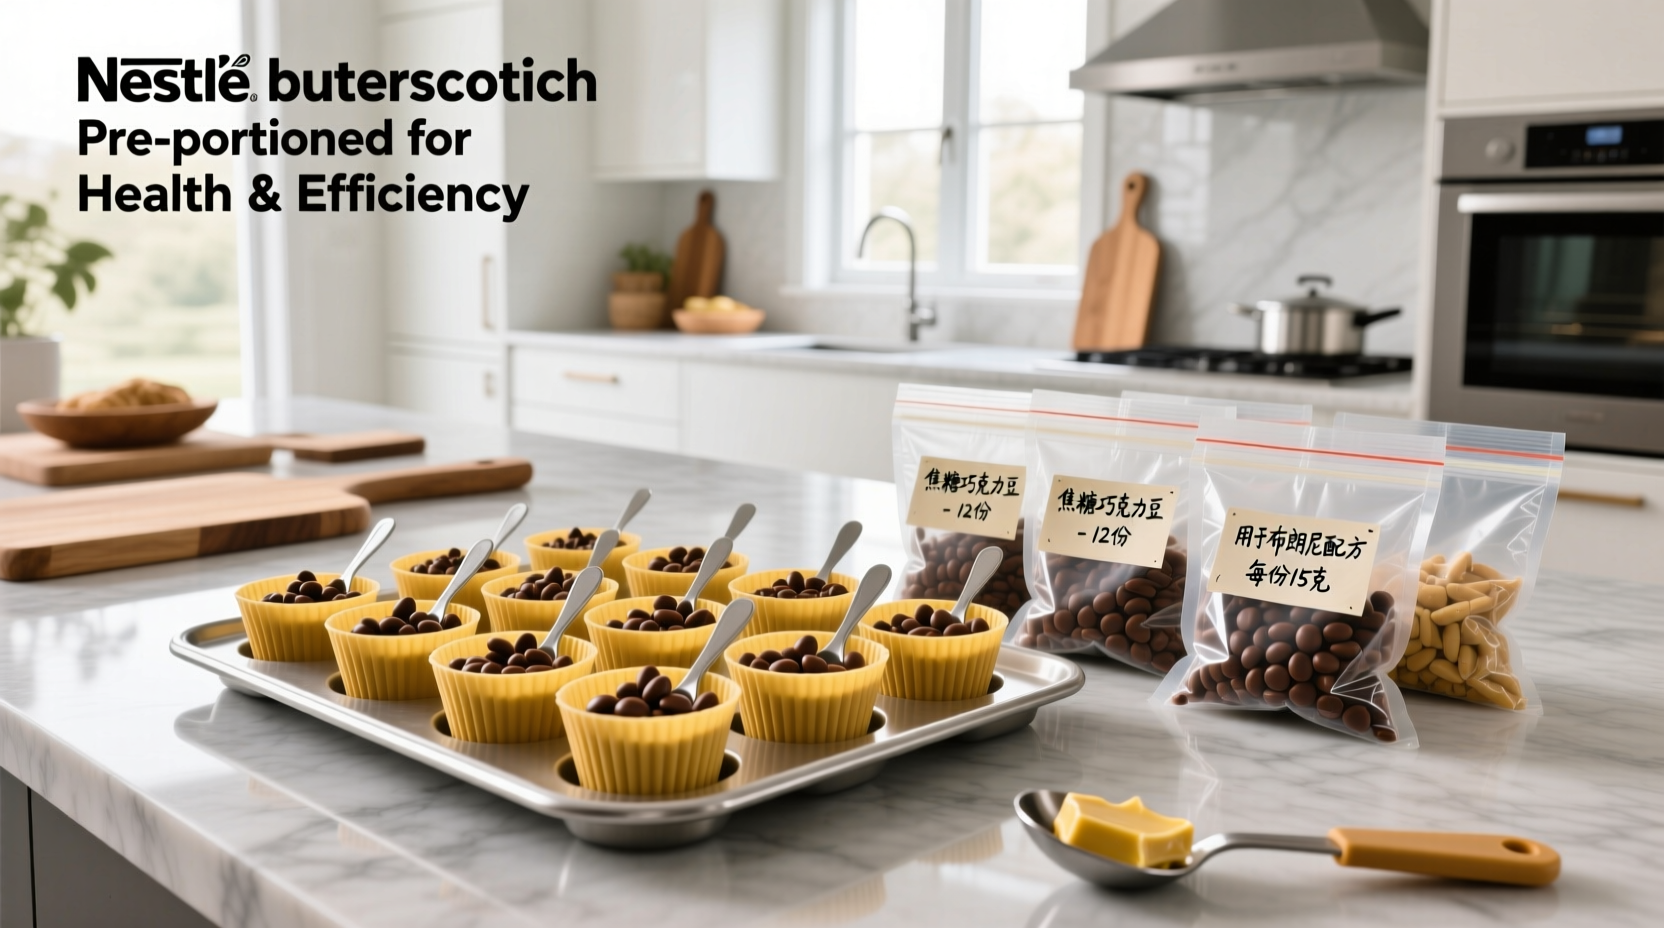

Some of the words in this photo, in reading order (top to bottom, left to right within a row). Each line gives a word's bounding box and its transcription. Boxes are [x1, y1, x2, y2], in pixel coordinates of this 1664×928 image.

[924, 467, 1020, 497] 焦糖巧克力豆
[957, 501, 992, 522] 12份
[1057, 487, 1164, 520] 焦糖巧克力豆
[1092, 525, 1132, 548] 12份
[1234, 525, 1368, 560] 用于布朗尼配方
[1245, 559, 1331, 593] 每份15克
